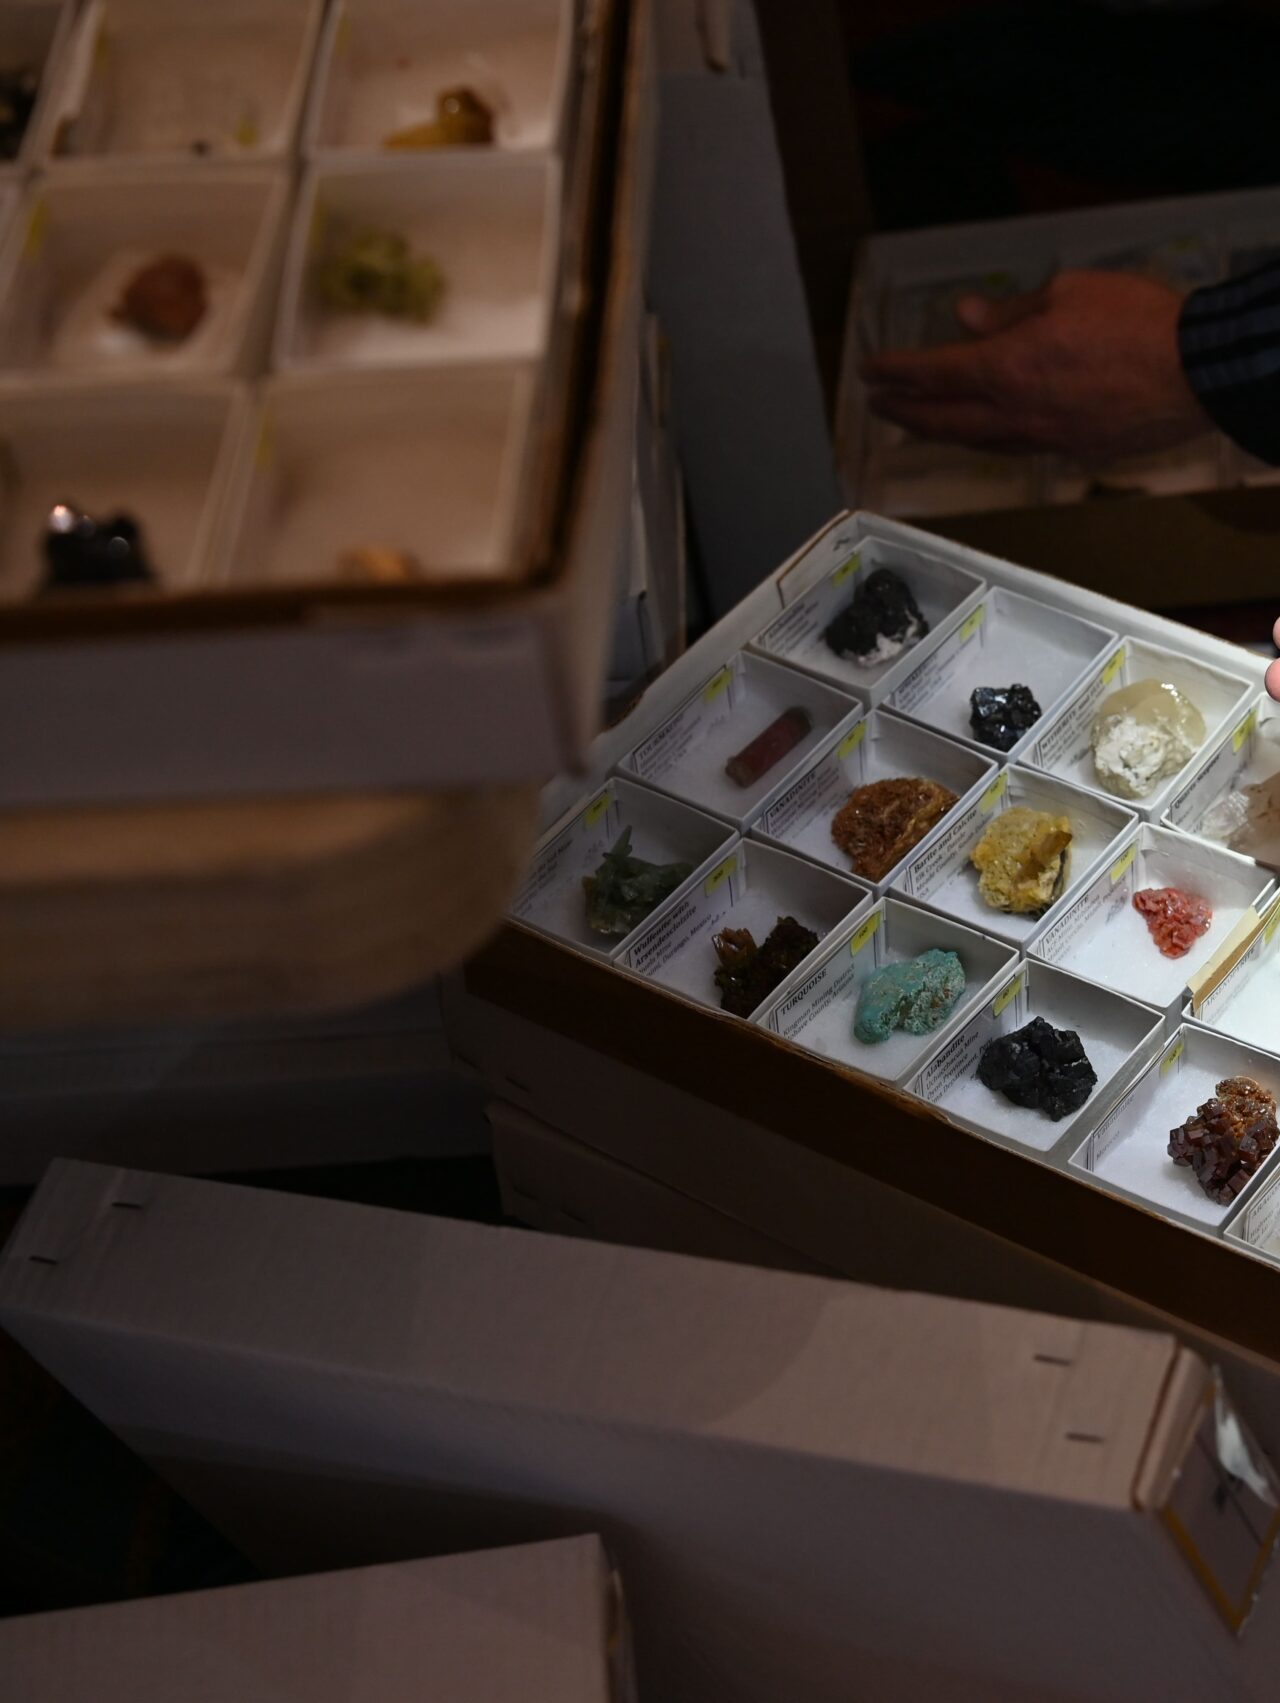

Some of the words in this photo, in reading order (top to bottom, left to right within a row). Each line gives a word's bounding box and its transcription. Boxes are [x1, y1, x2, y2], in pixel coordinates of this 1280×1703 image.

[914, 848, 938, 874] Barite
[938, 832, 952, 850] and
[953, 809, 977, 836] Calcite
[633, 918, 672, 956] Wulfenite
[673, 901, 690, 919] with
[1045, 893, 1089, 944] VANADINITE
[780, 968, 829, 1016] TURQUOISE
[784, 1008, 811, 1037] Kingman
[811, 985, 833, 1010] Mining
[925, 1033, 965, 1081] Alabandite
[964, 1031, 979, 1049] Mine
